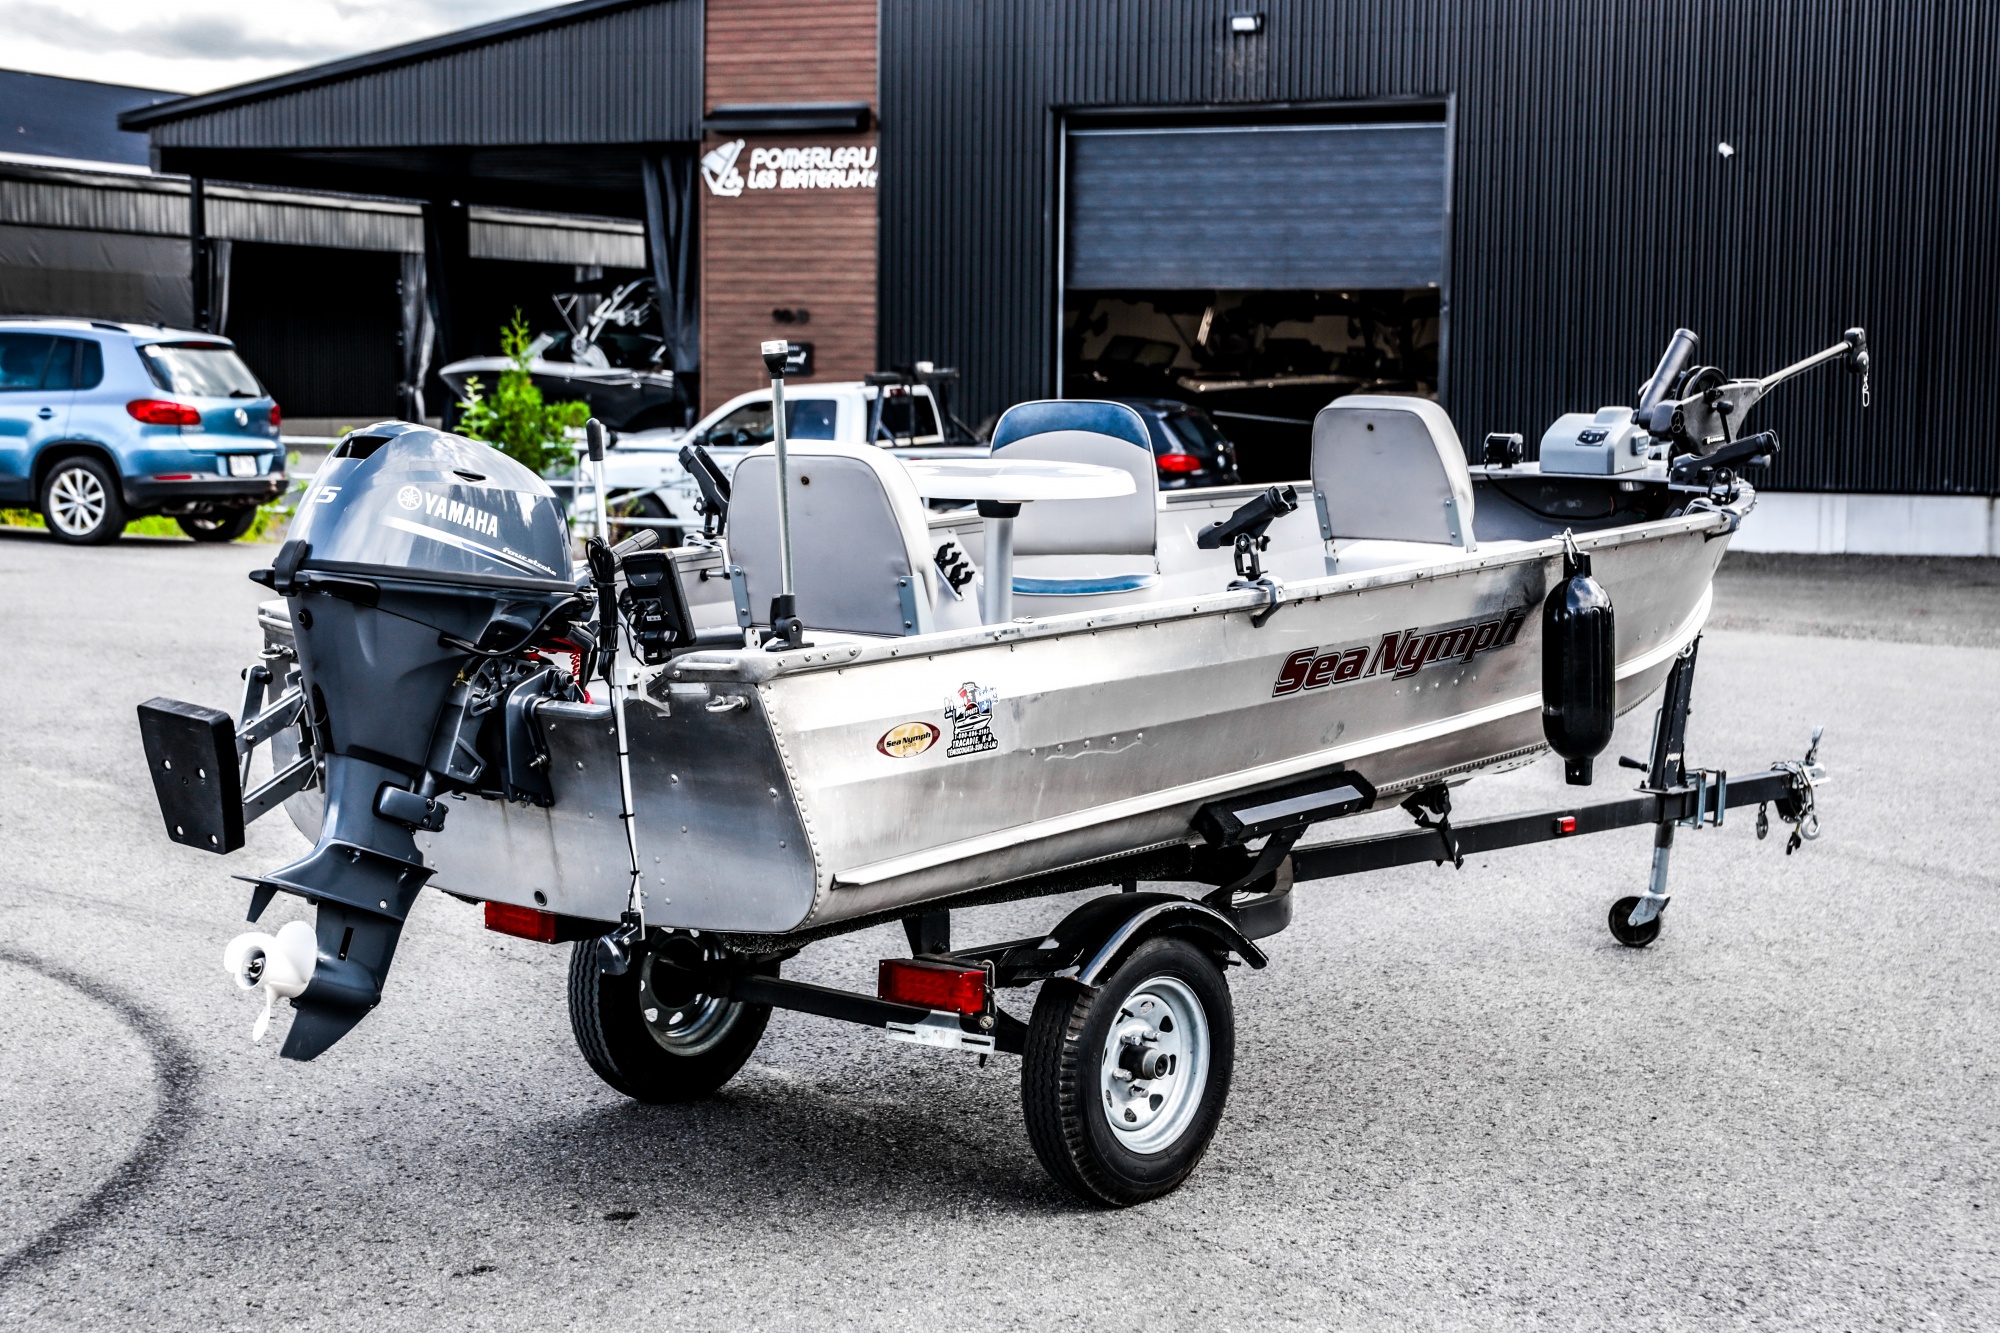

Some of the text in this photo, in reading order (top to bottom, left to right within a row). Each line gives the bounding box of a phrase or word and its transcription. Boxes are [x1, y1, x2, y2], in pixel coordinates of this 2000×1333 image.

[750, 146, 877, 170] POMERLEAU
[747, 169, 777, 189] LES
[307, 485, 342, 504] 15
[425, 491, 498, 538] YAMAHA
[1272, 606, 1526, 697] Sea Nymph
[886, 739, 901, 748] Sea
[902, 732, 931, 744] Nymph
